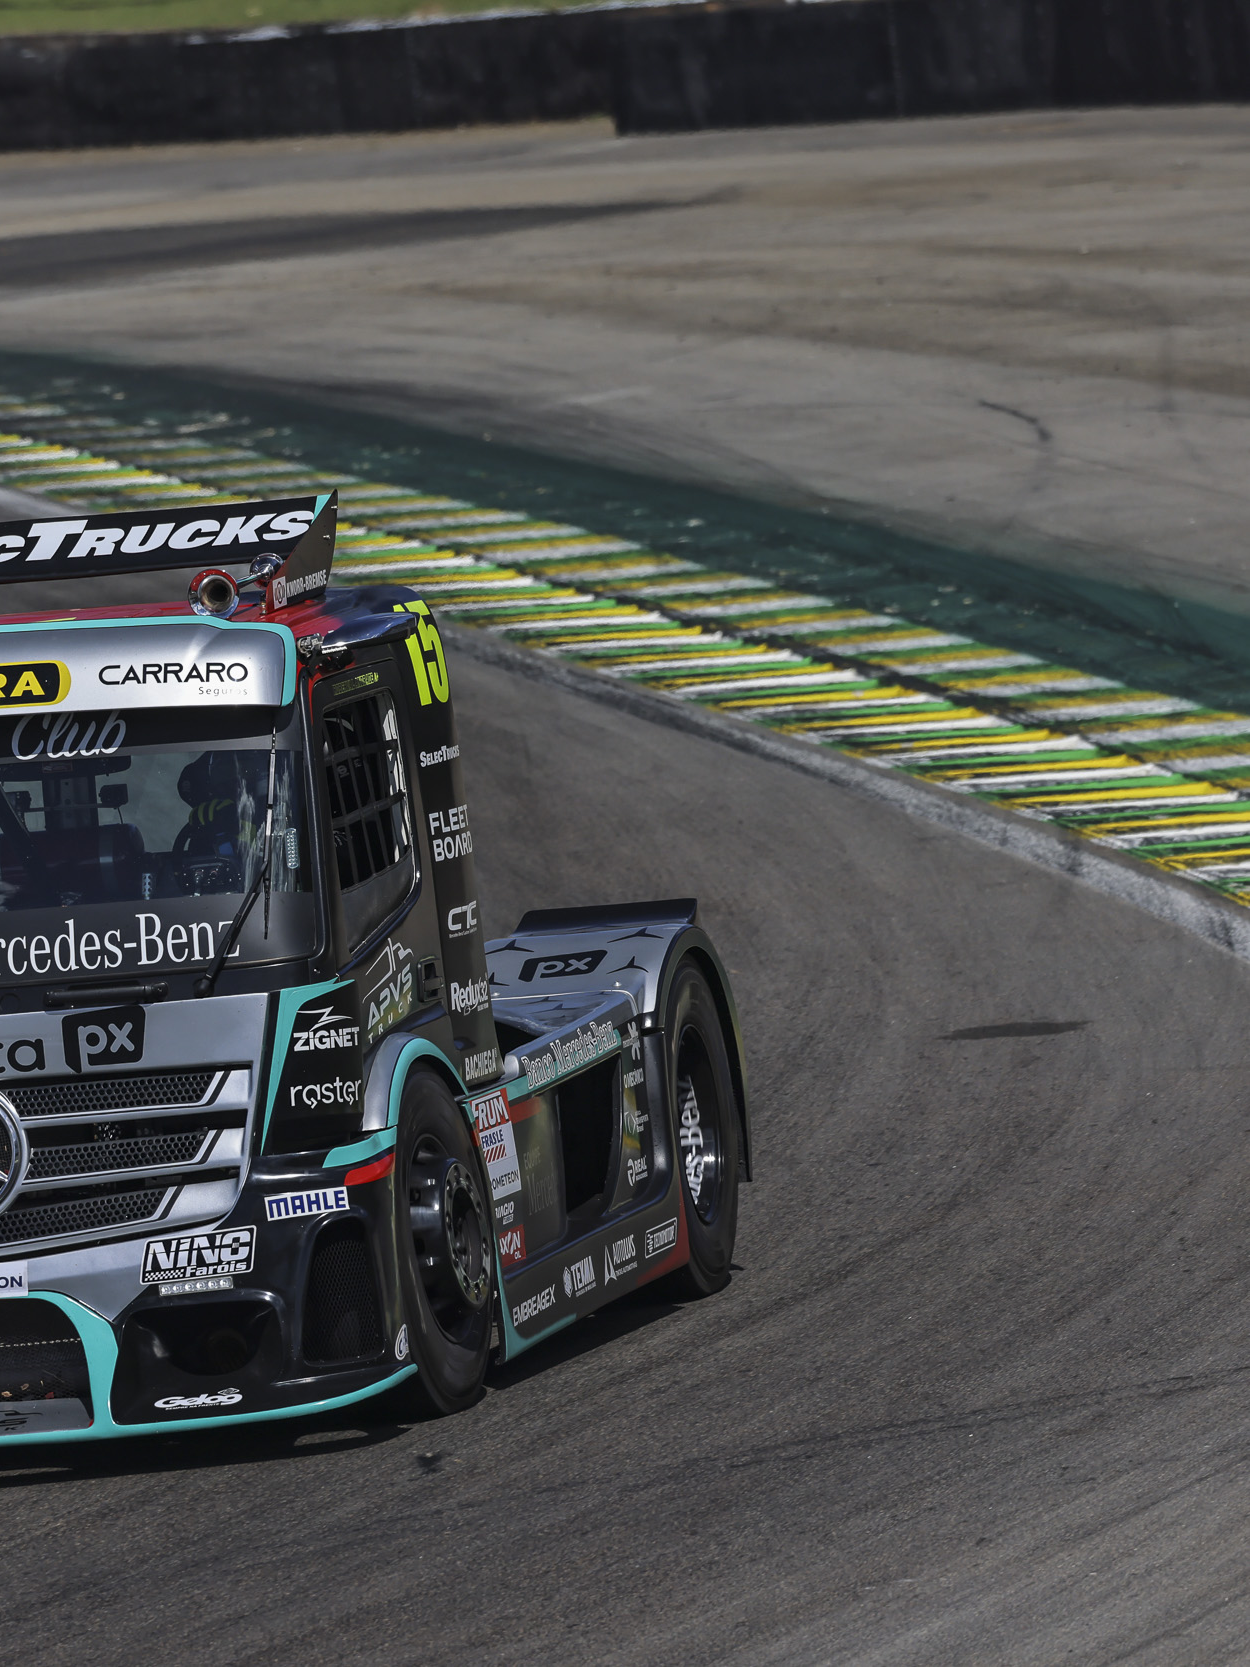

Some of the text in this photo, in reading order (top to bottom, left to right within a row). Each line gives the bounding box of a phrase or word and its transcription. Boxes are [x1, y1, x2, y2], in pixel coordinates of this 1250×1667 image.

[287, 569, 327, 598] KNORR-BREMSE
[98, 662, 249, 686] CARRARO
[11, 710, 128, 761] Club
[428, 803, 468, 836] FLEET
[433, 830, 473, 862] BOARD
[532, 957, 592, 983] px
[367, 962, 413, 1030] APVS
[367, 993, 414, 1045] TRUCK
[77, 1021, 135, 1074] px
[293, 1026, 360, 1052] ZIGNET
[465, 1051, 498, 1082] BACHIEGA
[520, 1052, 556, 1090] Banco
[290, 1076, 362, 1109] raster
[491, 1168, 519, 1191] OMETEON
[267, 1189, 347, 1219] MAHLE
[185, 1260, 248, 1278] Faróis
[512, 1283, 556, 1327] EMBREAGEX
